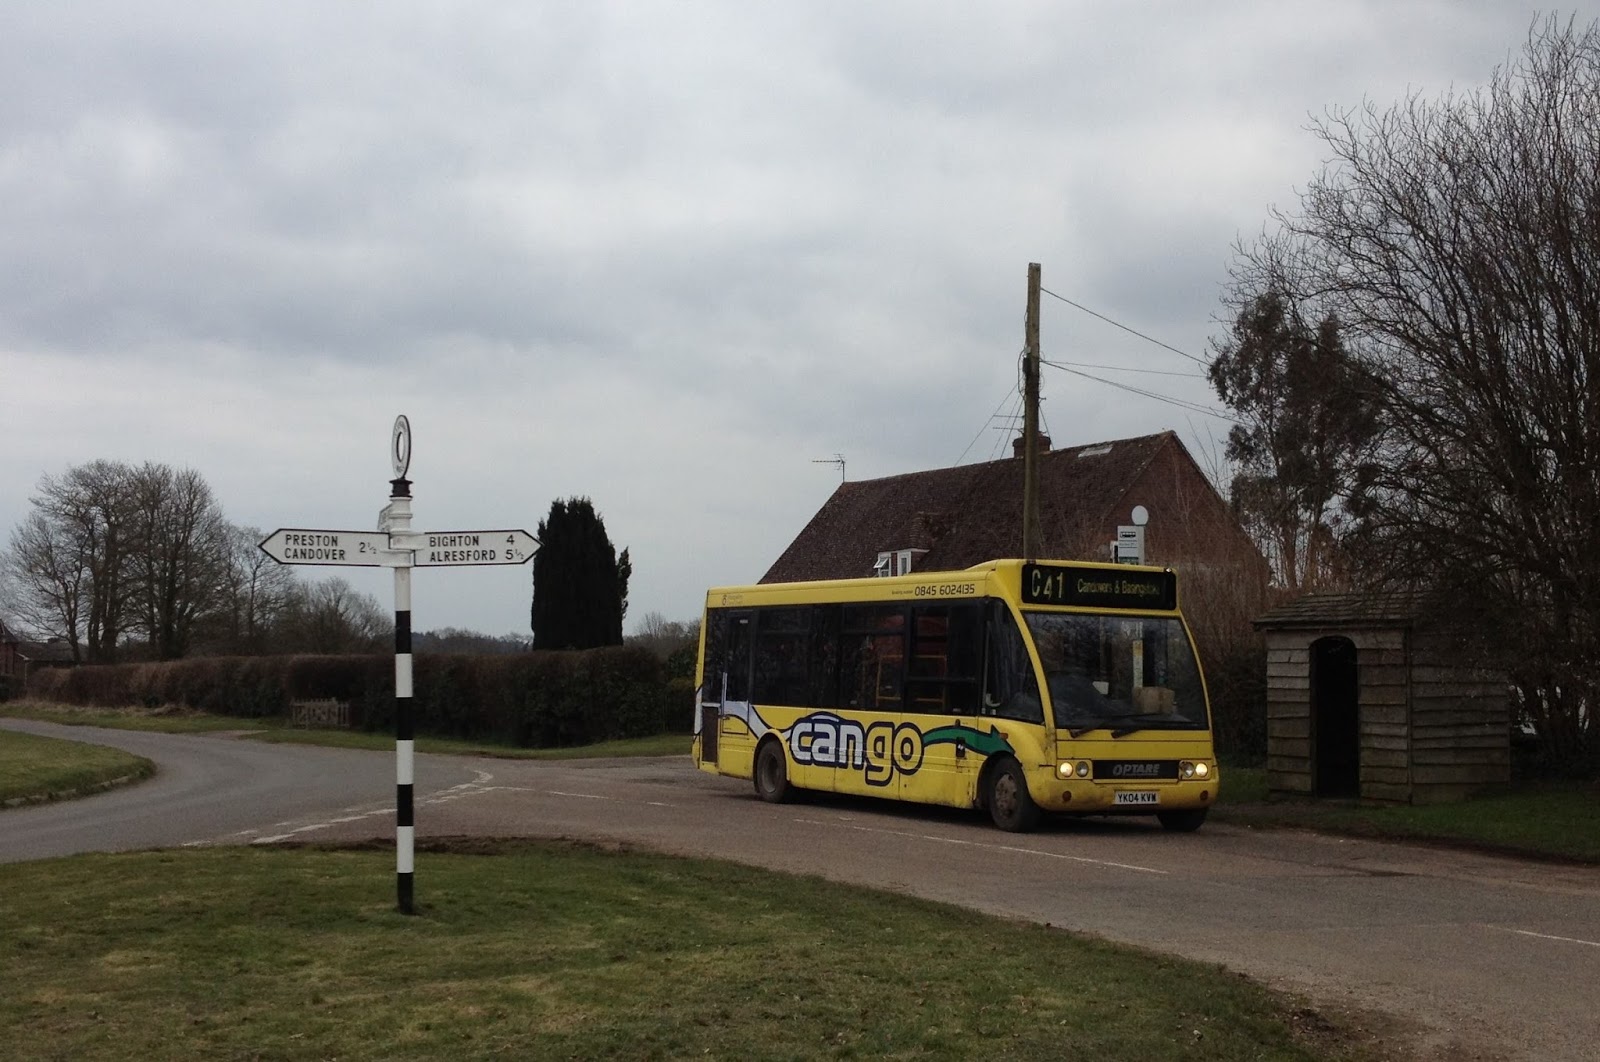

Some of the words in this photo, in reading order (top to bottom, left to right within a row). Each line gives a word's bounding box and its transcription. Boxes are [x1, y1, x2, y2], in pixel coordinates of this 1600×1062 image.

[285, 534, 338, 547] PRESTON
[429, 535, 480, 547] BIGHTON
[506, 534, 515, 545] 4
[284, 547, 346, 560] CANDOVER
[430, 549, 496, 562] ALRESFORD
[914, 585, 937, 597] 0845
[939, 583, 975, 595] 6024135
[1031, 568, 1064, 599] C41
[790, 717, 924, 786] cango
[1112, 763, 1160, 776] OPTARE
[1118, 793, 1139, 803] YK04
